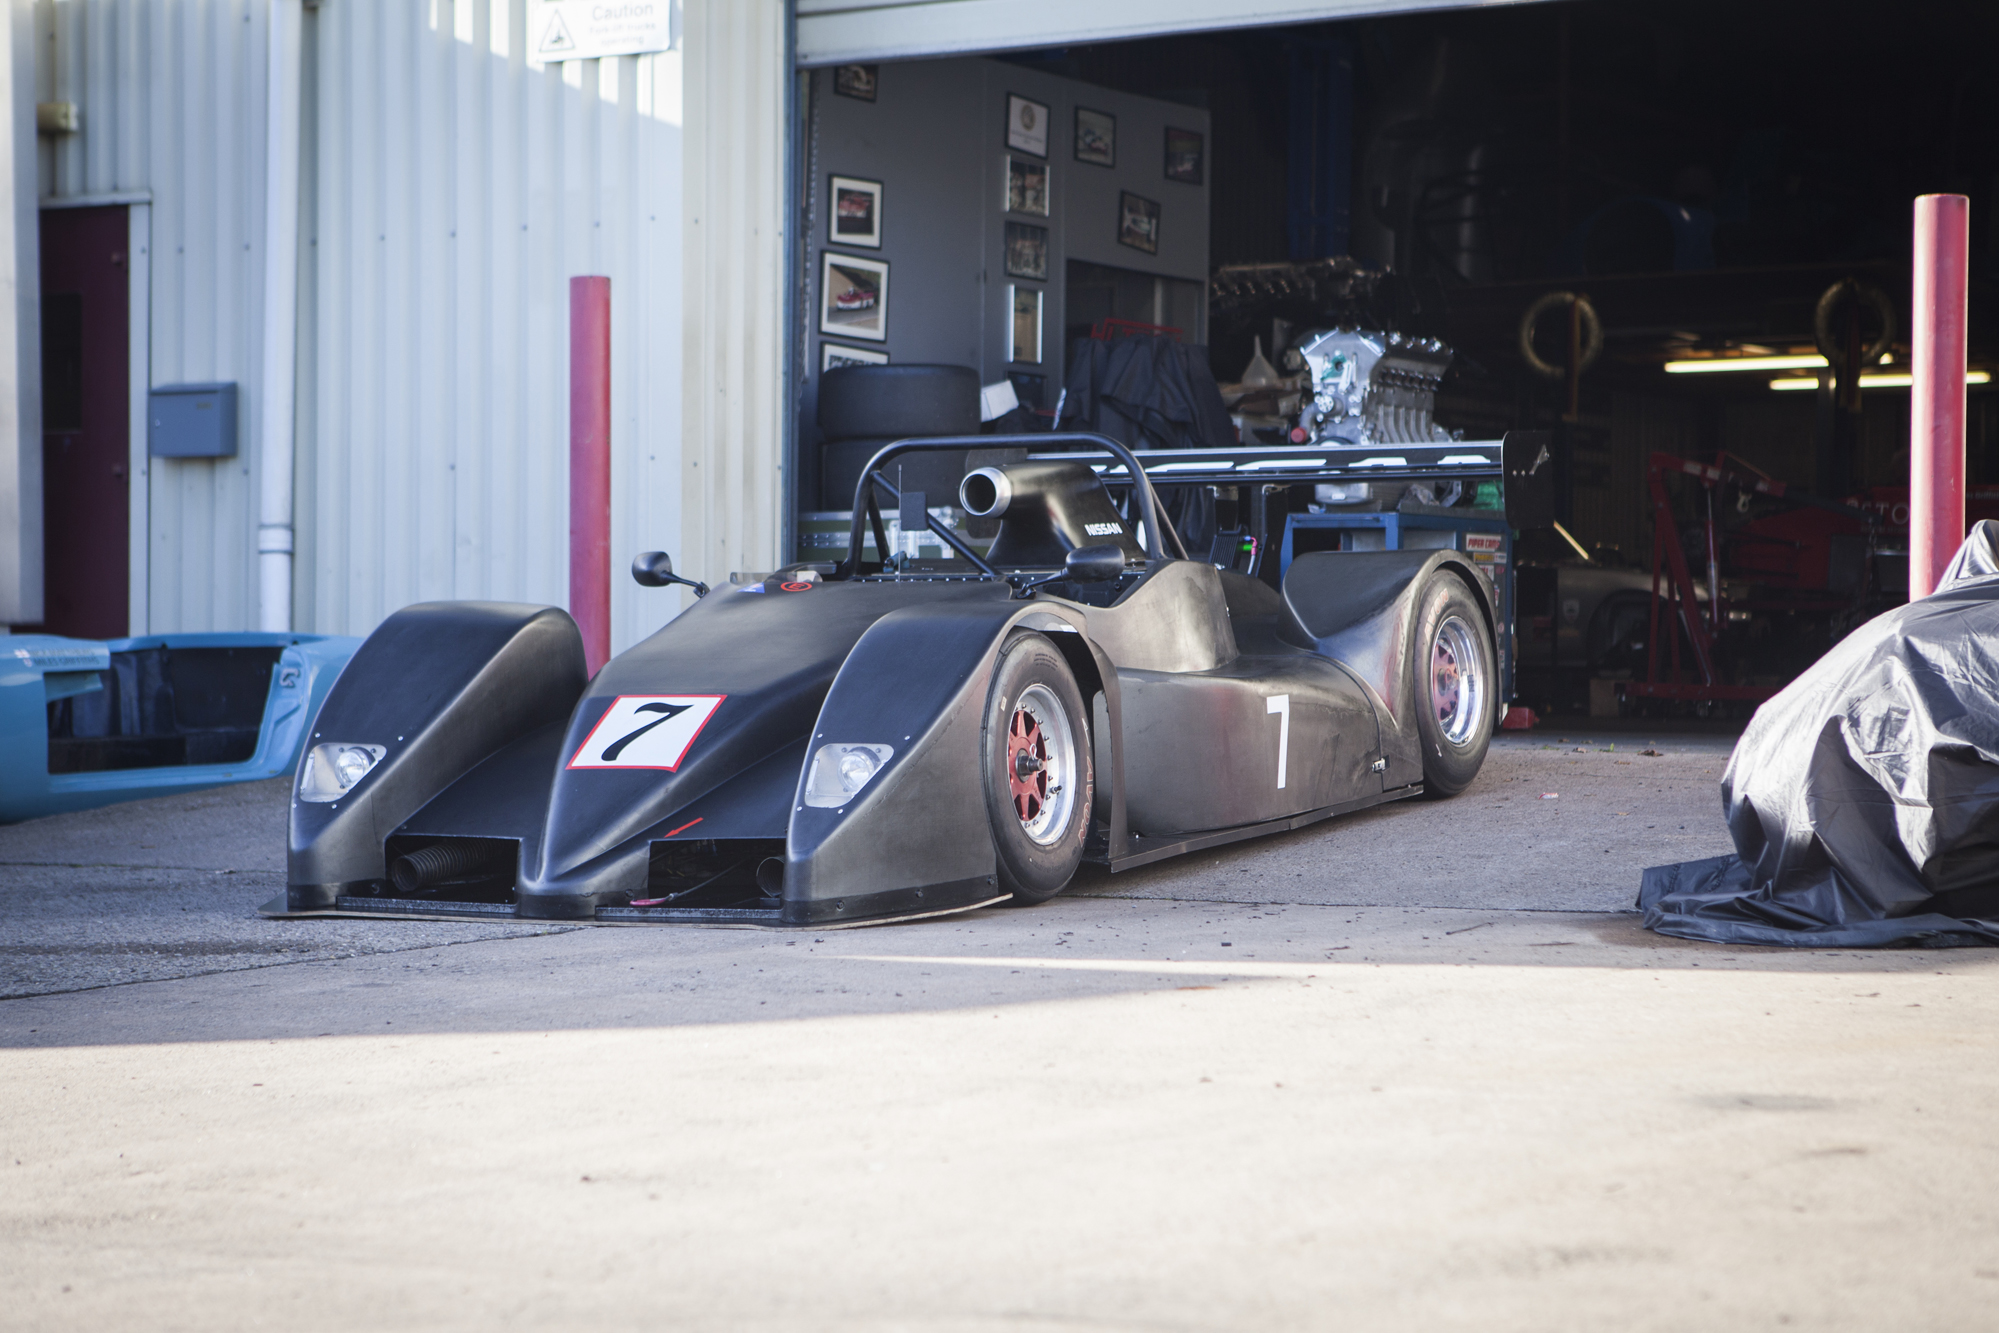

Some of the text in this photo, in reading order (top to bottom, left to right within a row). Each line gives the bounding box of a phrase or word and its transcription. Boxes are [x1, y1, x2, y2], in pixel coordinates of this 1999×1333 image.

[592, 4, 653, 21] Caution
[1084, 522, 1123, 536] NISSAN
[1424, 587, 1449, 645] AVON
[601, 702, 695, 762] 7
[1078, 756, 1093, 847] AVON
